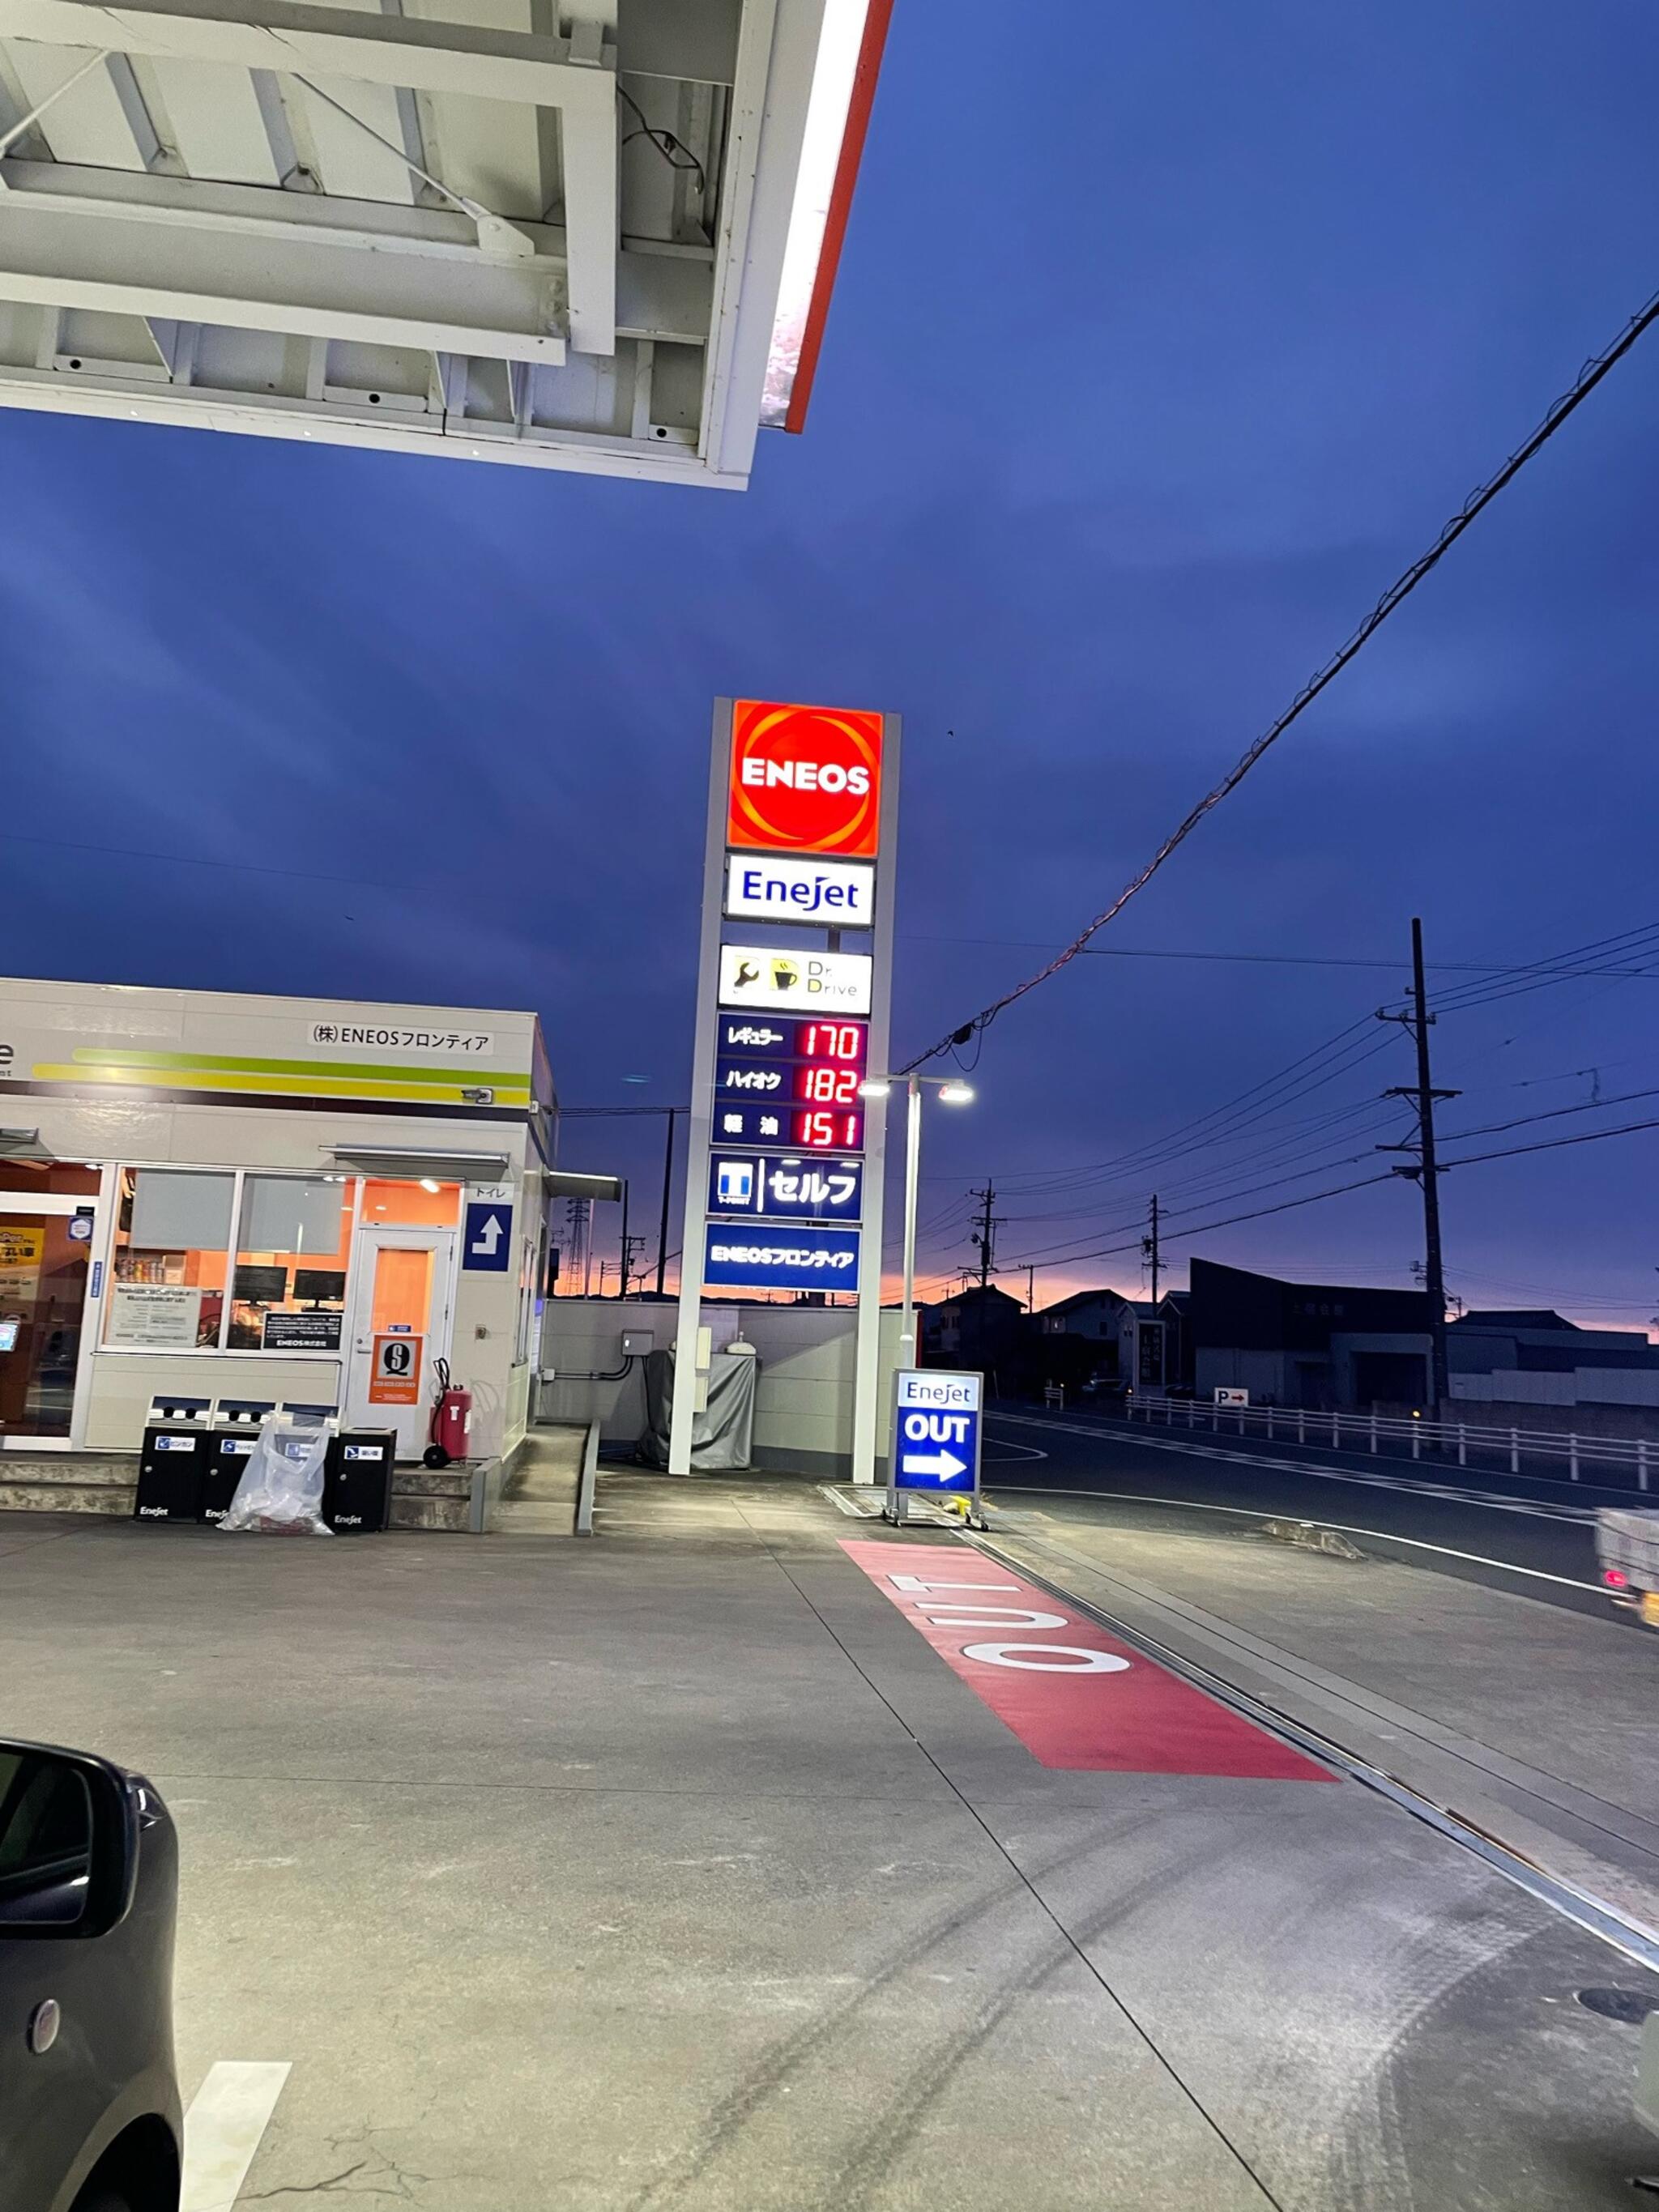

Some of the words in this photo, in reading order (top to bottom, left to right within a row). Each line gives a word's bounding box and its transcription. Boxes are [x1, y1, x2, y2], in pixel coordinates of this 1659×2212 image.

[742, 757, 870, 795] ENEOS
[728, 1026, 783, 1046] レギュラー
[807, 1025, 859, 1059] 170
[726, 1070, 782, 1090] ハイオク
[804, 1068, 857, 1103] 182
[803, 1112, 856, 1146] 151
[477, 1187, 505, 1198] トイレ
[769, 1170, 856, 1204] セルフ
[710, 1245, 855, 1268] ENEOSフロンティア
[1218, 1391, 1229, 1404] P
[904, 1413, 970, 1443] OUT
[887, 1575, 1132, 1673] OUT
